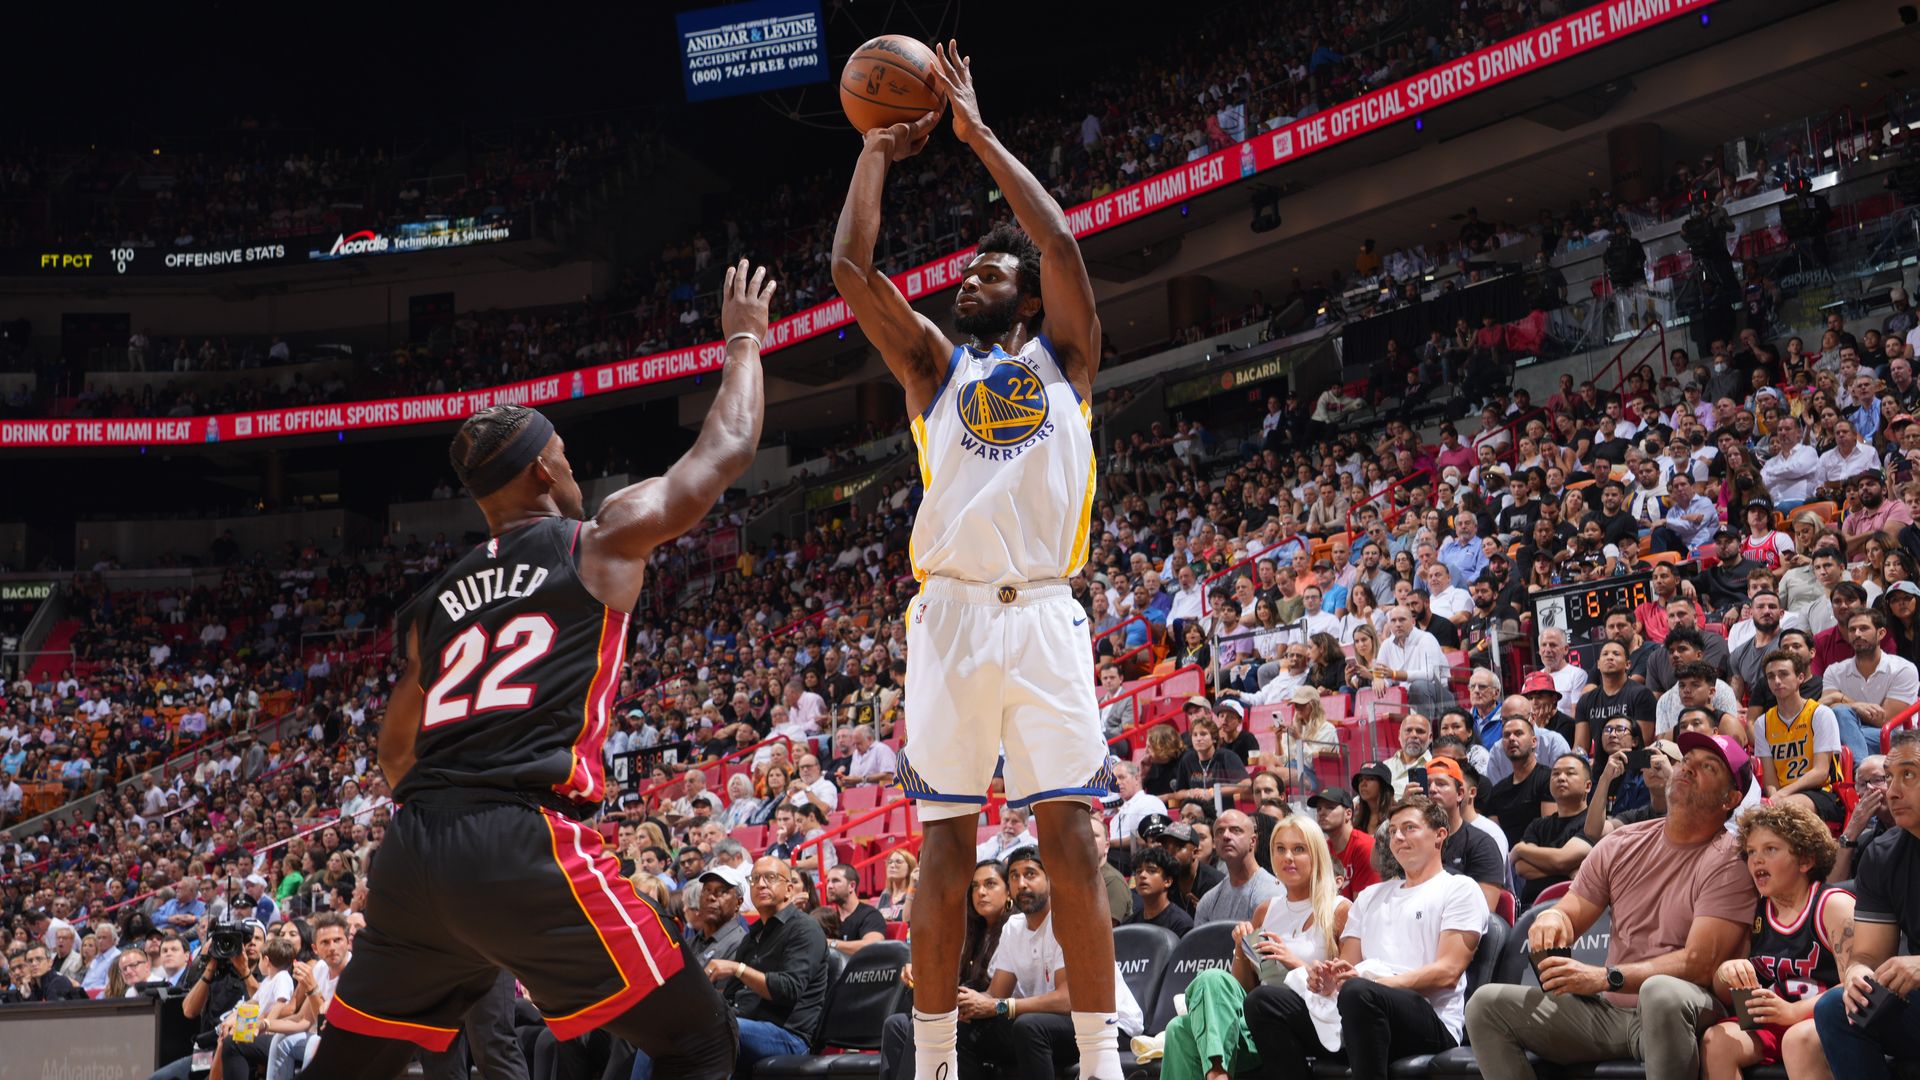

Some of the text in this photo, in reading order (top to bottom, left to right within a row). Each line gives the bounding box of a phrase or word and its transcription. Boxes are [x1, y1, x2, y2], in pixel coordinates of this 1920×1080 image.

[686, 18, 817, 53] ANIDJAR & LEVINE
[689, 38, 818, 69] ACCIDENT ATTORNEYS
[692, 54, 818, 85] (800) 747-FREE (3733)
[1297, 117, 1328, 149] THE
[1331, 88, 1405, 137] OFFICIAL
[1407, 62, 1475, 108] SPORTS
[1478, 37, 1536, 81] DRINK
[1538, 26, 1563, 59] OF
[1567, 10, 1605, 48] THE
[1067, 156, 1225, 236] RINK OF THE MIAMI HEAT
[110, 248, 135, 262] 100
[165, 244, 285, 268] OFFENSIVE STATS
[330, 231, 388, 256] Acordis
[394, 235, 449, 249] Technology
[462, 227, 510, 241] Solutions
[41, 254, 93, 268] FT PCT
[924, 262, 948, 289] THE
[776, 321, 791, 344] OF
[792, 313, 812, 338] THE
[813, 301, 844, 327] MIAMI
[616, 343, 726, 385] THE OFFICIAL SPO
[1236, 356, 1280, 385] BACARDÍ
[1007, 377, 1040, 401] 22
[257, 379, 560, 433] THE OFFICIAL SPORTS DRINK OF THE MIAMI HEAT
[2, 421, 191, 443] DRINK OF THE MIAMI HEAT
[960, 420, 1055, 461] WARRIORS
[2, 583, 54, 599] BACARD
[438, 564, 549, 622] BUTLER
[422, 612, 559, 731] 22
[1786, 758, 1809, 779] 22
[1520, 933, 1610, 954] AANT
[845, 969, 897, 984] AMERANT
[1116, 959, 1149, 974] RANT
[1174, 959, 1233, 974] AMERAN
